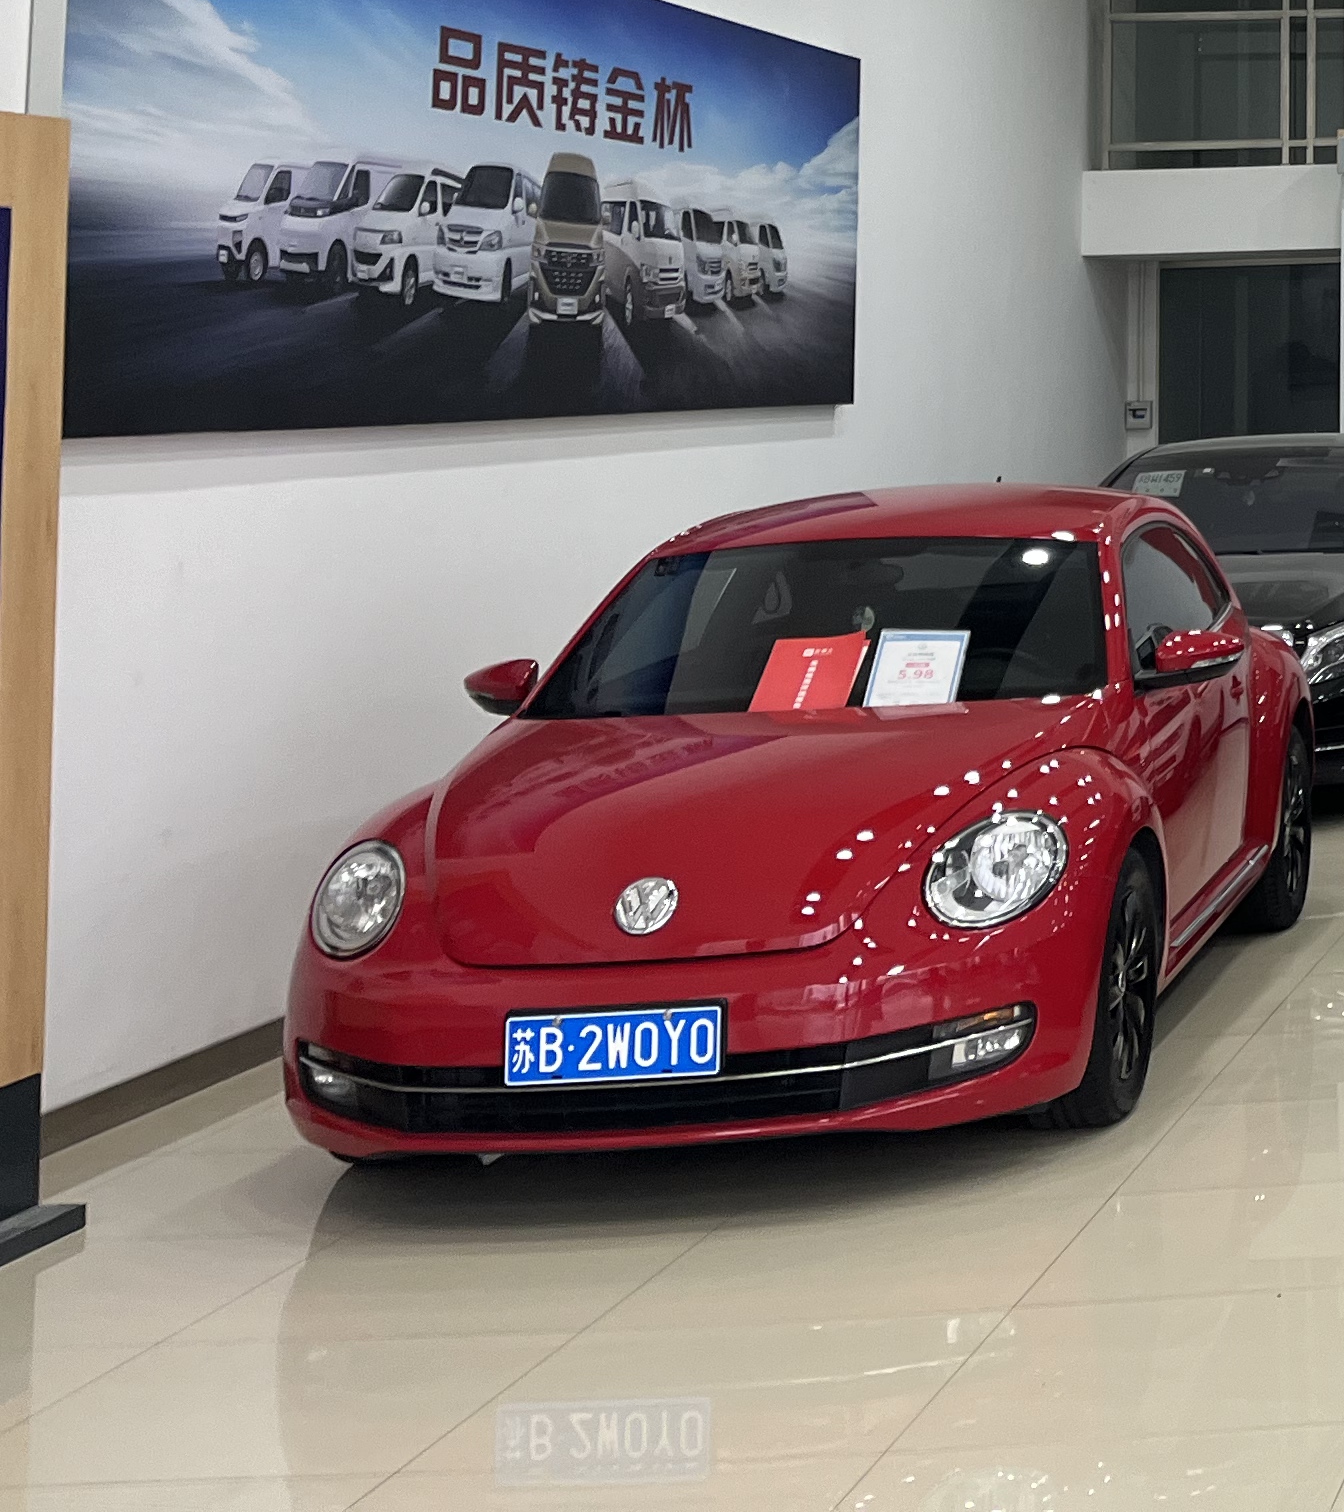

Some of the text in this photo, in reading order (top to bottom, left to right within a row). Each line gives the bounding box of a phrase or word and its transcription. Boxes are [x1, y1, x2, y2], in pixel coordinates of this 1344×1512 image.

[431, 25, 693, 153] 品质铸金杯
